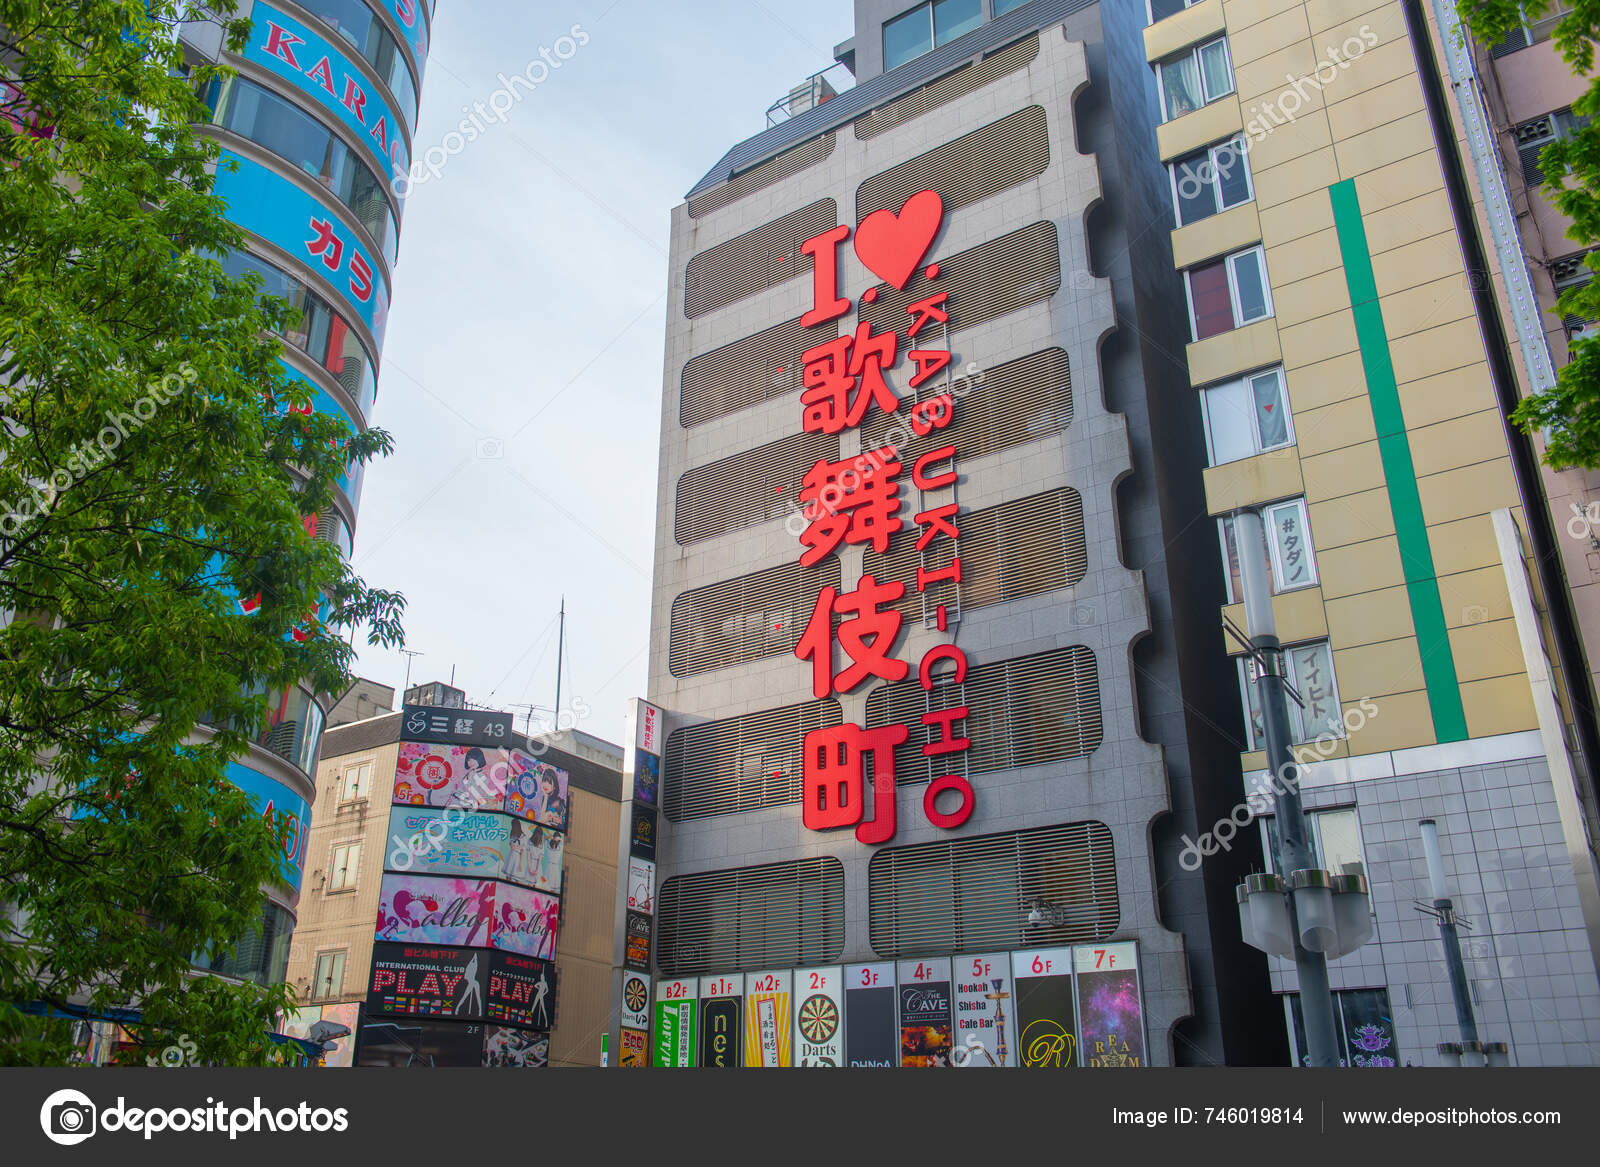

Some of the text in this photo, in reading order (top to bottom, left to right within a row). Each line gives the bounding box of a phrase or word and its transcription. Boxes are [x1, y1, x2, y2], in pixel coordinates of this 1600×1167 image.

[792, 224, 910, 845] I 歌舞伎町
[906, 292, 975, 829] KABUKI-CHO
[1302, 651, 1327, 719] イイヒト
[483, 722, 505, 737] 43
[399, 789, 413, 800] 5F
[510, 799, 520, 812] 5F
[376, 961, 465, 974] INTERNATIONAL CLUB
[1031, 955, 1052, 974] 6F
[1093, 949, 1116, 969] 7F
[913, 962, 932, 981] 4F
[972, 959, 991, 977] 5F
[373, 969, 464, 997] PLAY
[754, 974, 780, 992] M2F
[809, 972, 826, 989] 2F
[861, 968, 879, 986] 3F
[489, 976, 534, 1004] PLAY
[666, 982, 688, 998] B2F
[711, 978, 732, 995] B1F
[957, 983, 988, 993] Hookah
[958, 1000, 986, 1012] Shisha
[466, 1026, 480, 1034] 2F
[959, 1018, 994, 1029] Cafe Bar
[801, 1043, 837, 1057] Darts
